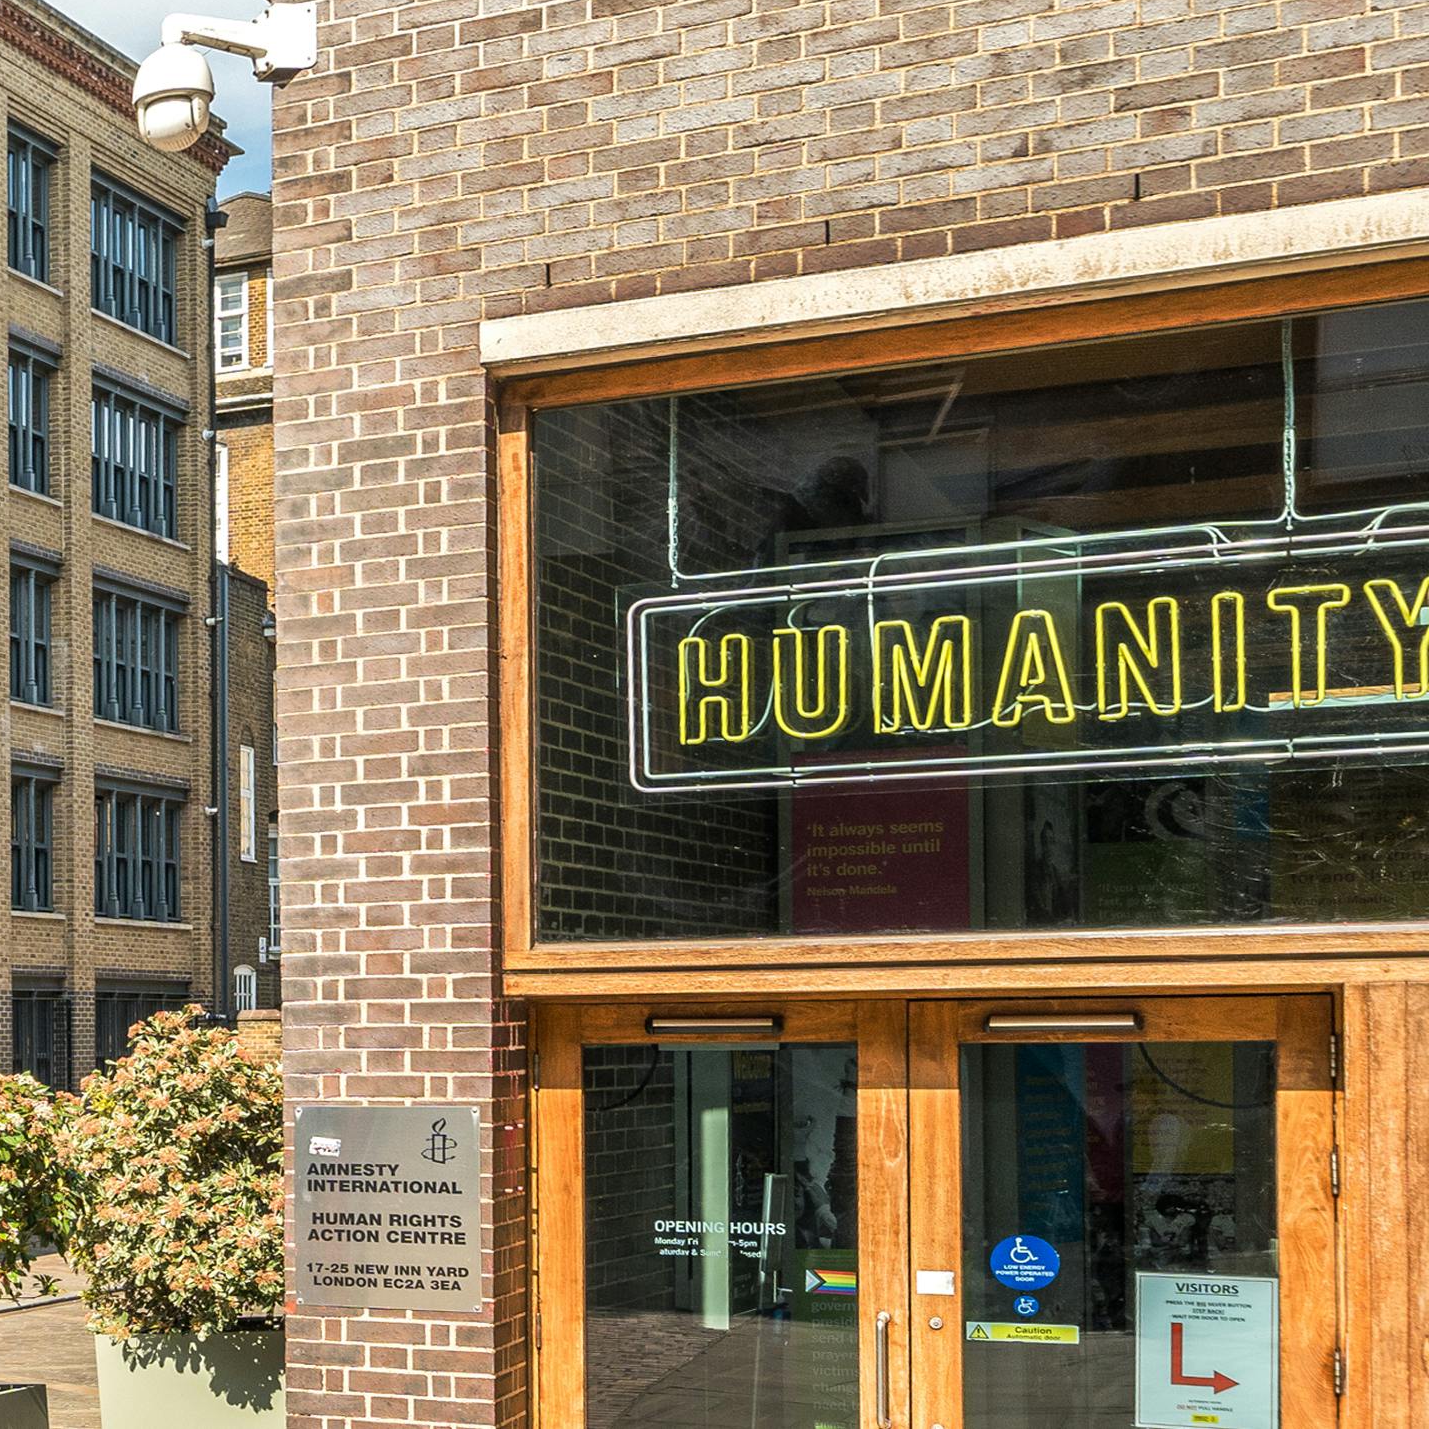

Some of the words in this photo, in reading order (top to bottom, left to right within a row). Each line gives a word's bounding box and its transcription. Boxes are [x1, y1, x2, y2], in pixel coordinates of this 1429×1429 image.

[678, 577, 1429, 746] HUMANITY
[829, 822, 885, 838] always
[889, 821, 945, 835] seems
[807, 840, 897, 858] impossible
[901, 838, 941, 854] until
[807, 863, 831, 878] it's
[807, 885, 846, 897] Nelson
[849, 884, 898, 896] Mandela
[306, 1162, 400, 1177] AMNESTY
[306, 1179, 463, 1195] INTERNATIONAL
[311, 1212, 382, 1227] HUMAN
[388, 1213, 462, 1228] RIGHTS
[654, 1220, 725, 1234] OPENING
[729, 1221, 786, 1235] HOURS
[307, 1229, 380, 1243] ACTION
[386, 1230, 467, 1245] CENTRE
[654, 1236, 686, 1247] Monday
[306, 1262, 349, 1274] 17-25
[354, 1264, 390, 1275] NEW
[394, 1265, 422, 1276] INN
[426, 1266, 469, 1278] YARD
[313, 1275, 378, 1288] LONDON
[383, 1278, 425, 1290] EC2A
[430, 1280, 462, 1291] 3EA
[1175, 1282, 1240, 1295] VISITORS
[1006, 1333, 1041, 1341] Automatic
[1014, 1326, 1052, 1335] Caution
